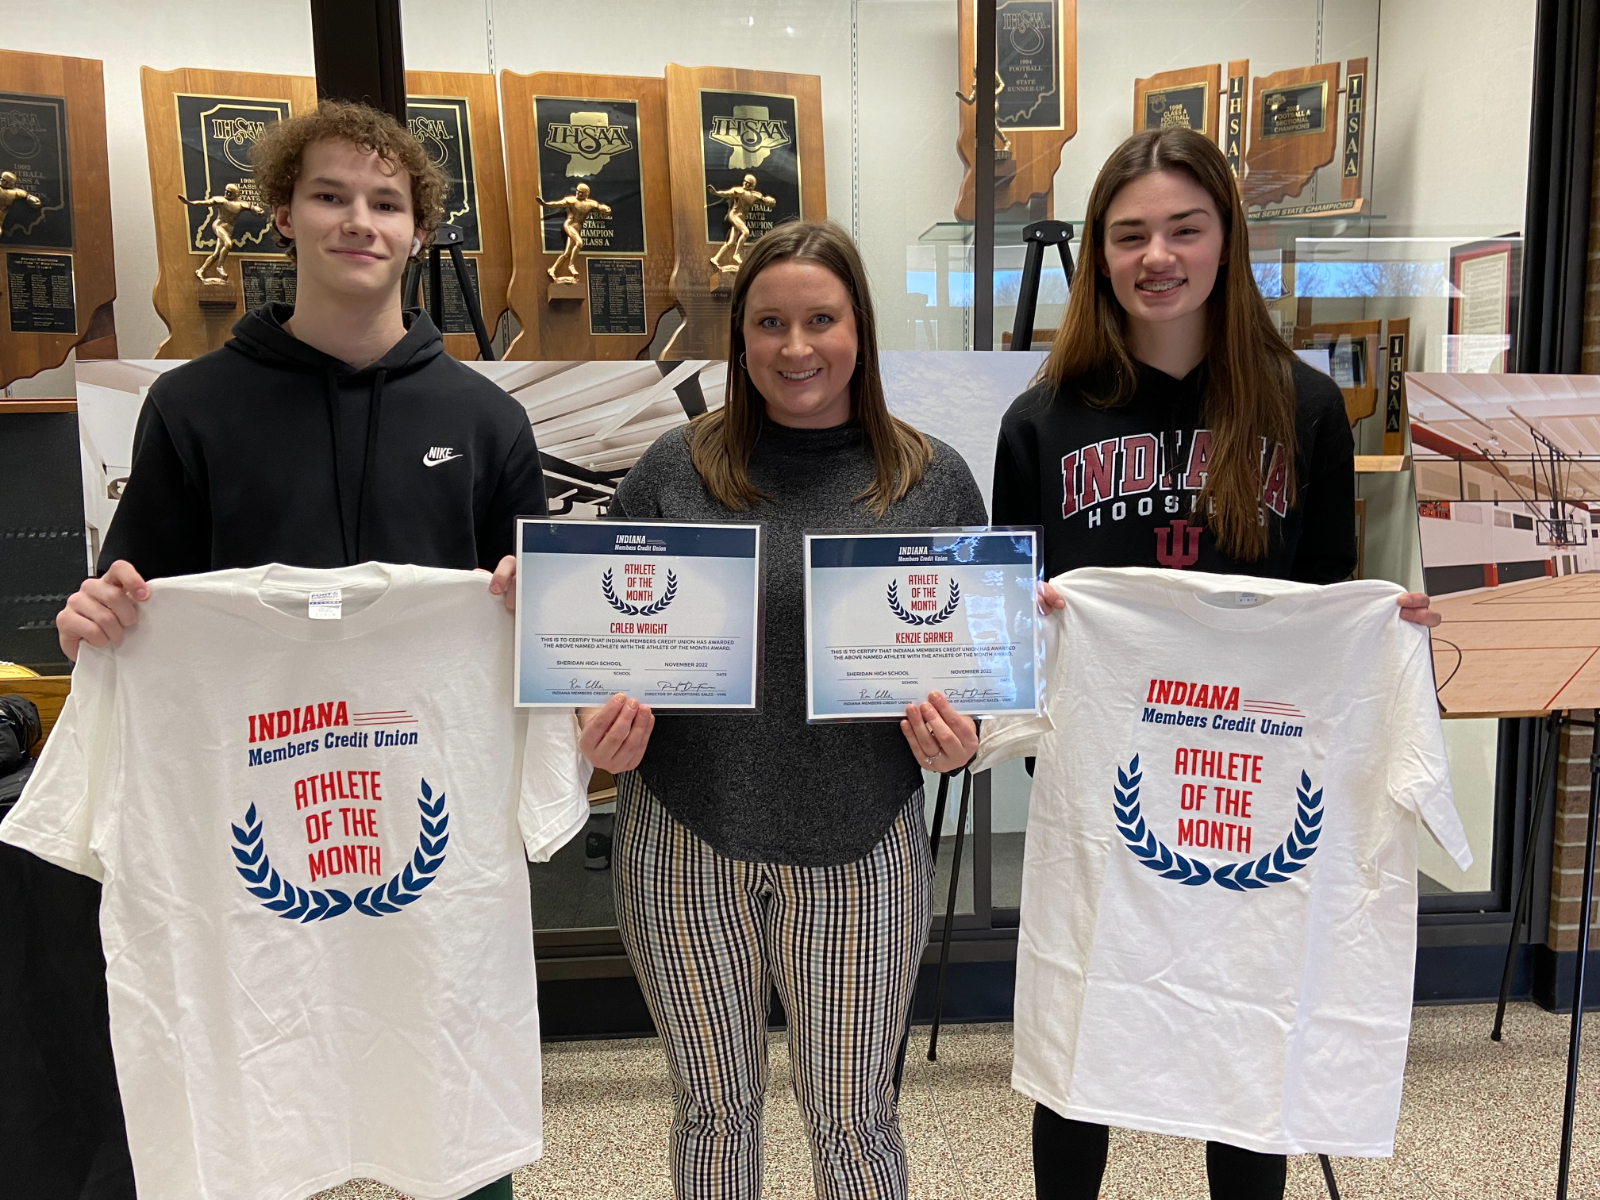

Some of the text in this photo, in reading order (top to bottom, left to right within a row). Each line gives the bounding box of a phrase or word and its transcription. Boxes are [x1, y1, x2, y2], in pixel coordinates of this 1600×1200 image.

[1161, 115, 1189, 123] FOOTBALL
[1274, 110, 1305, 120] FOOTBALL
[1276, 117, 1308, 126] SECTIONAL
[1346, 78, 1360, 175] IHSAA
[212, 117, 268, 143] IHSAA
[715, 118, 788, 148] IHSAA
[1274, 123, 1309, 133] CHAMPIONS
[550, 126, 628, 154] IHSAA
[1306, 201, 1353, 212] CHAMPIONS
[580, 230, 614, 238] HAMPION
[1387, 338, 1402, 429] IHSAA
[428, 446, 453, 459] NIKE
[616, 535, 646, 544] INDIANA
[899, 546, 928, 555] INDIANA
[624, 564, 656, 575] ATHLETE
[627, 577, 653, 588] OF THE
[908, 574, 938, 585] ATHLETE
[626, 590, 653, 601] MONTH
[912, 587, 936, 598] OF THE
[911, 600, 937, 611] MONTH
[610, 622, 668, 634] CALEB WRIGHT
[896, 631, 953, 643] KENZIE GARNER
[1146, 679, 1240, 711] INDIANA
[248, 701, 349, 743] INDIANA
[1142, 708, 1303, 737] Members Credit Union
[248, 730, 418, 767] Members Credit Union
[1174, 747, 1264, 784] ATHLETE
[294, 771, 382, 811] ATHLETE
[1180, 783, 1253, 818] OF THE
[306, 808, 379, 844] OF THE
[1177, 818, 1252, 854] MONTH
[308, 845, 381, 882] MONTH
